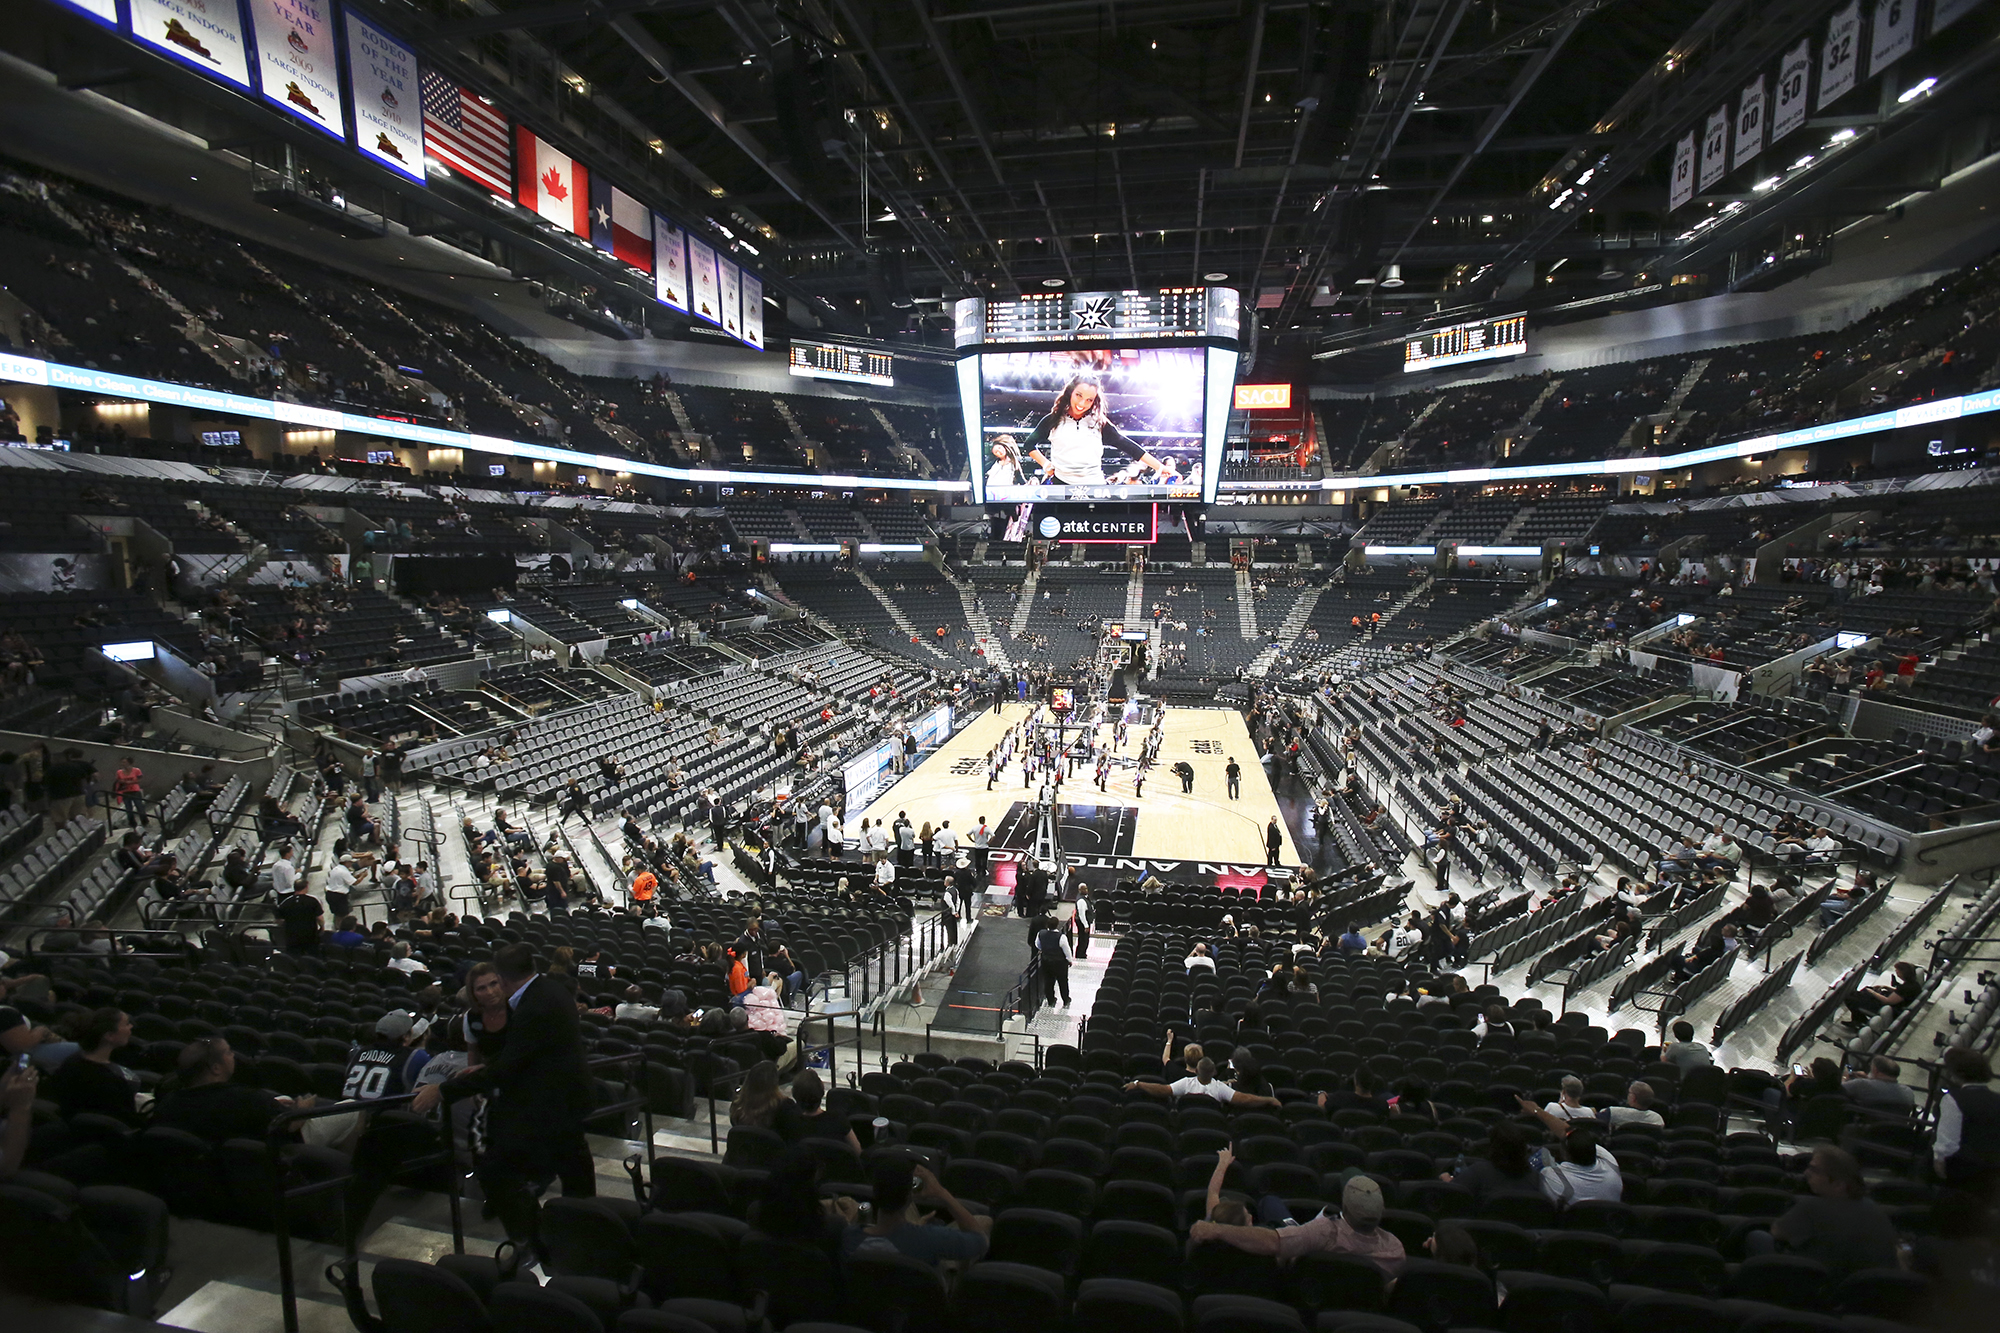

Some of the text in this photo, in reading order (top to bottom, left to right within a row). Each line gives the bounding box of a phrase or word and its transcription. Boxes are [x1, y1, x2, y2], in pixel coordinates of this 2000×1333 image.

[187, 11, 237, 43] INDOOR
[273, 1, 315, 36] YEAR
[1889, 0, 1902, 28] 6
[361, 26, 406, 63] RODEO
[1829, 35, 1850, 70] 32
[289, 51, 313, 73] 2009
[361, 43, 409, 80] OF THE
[267, 52, 336, 101] LARGE INDOOR
[371, 63, 404, 91] YEAR
[1782, 74, 1801, 106] 50
[362, 109, 418, 146] LARGE INDOOR
[382, 106, 402, 126] 2010
[1742, 106, 1758, 135] 00
[1707, 133, 1721, 160] 44
[1678, 160, 1688, 182] 13
[51, 369, 273, 415] Drive Clean. Clean Across America.
[1238, 389, 1287, 404] SACU
[1964, 398, 1991, 411] Drive
[1063, 520, 1145, 533] at&t CENTER
[1761, 670, 1773, 678] 22
[987, 851, 1293, 879] SAN ANTOIO
[342, 1065, 390, 1100] 20
